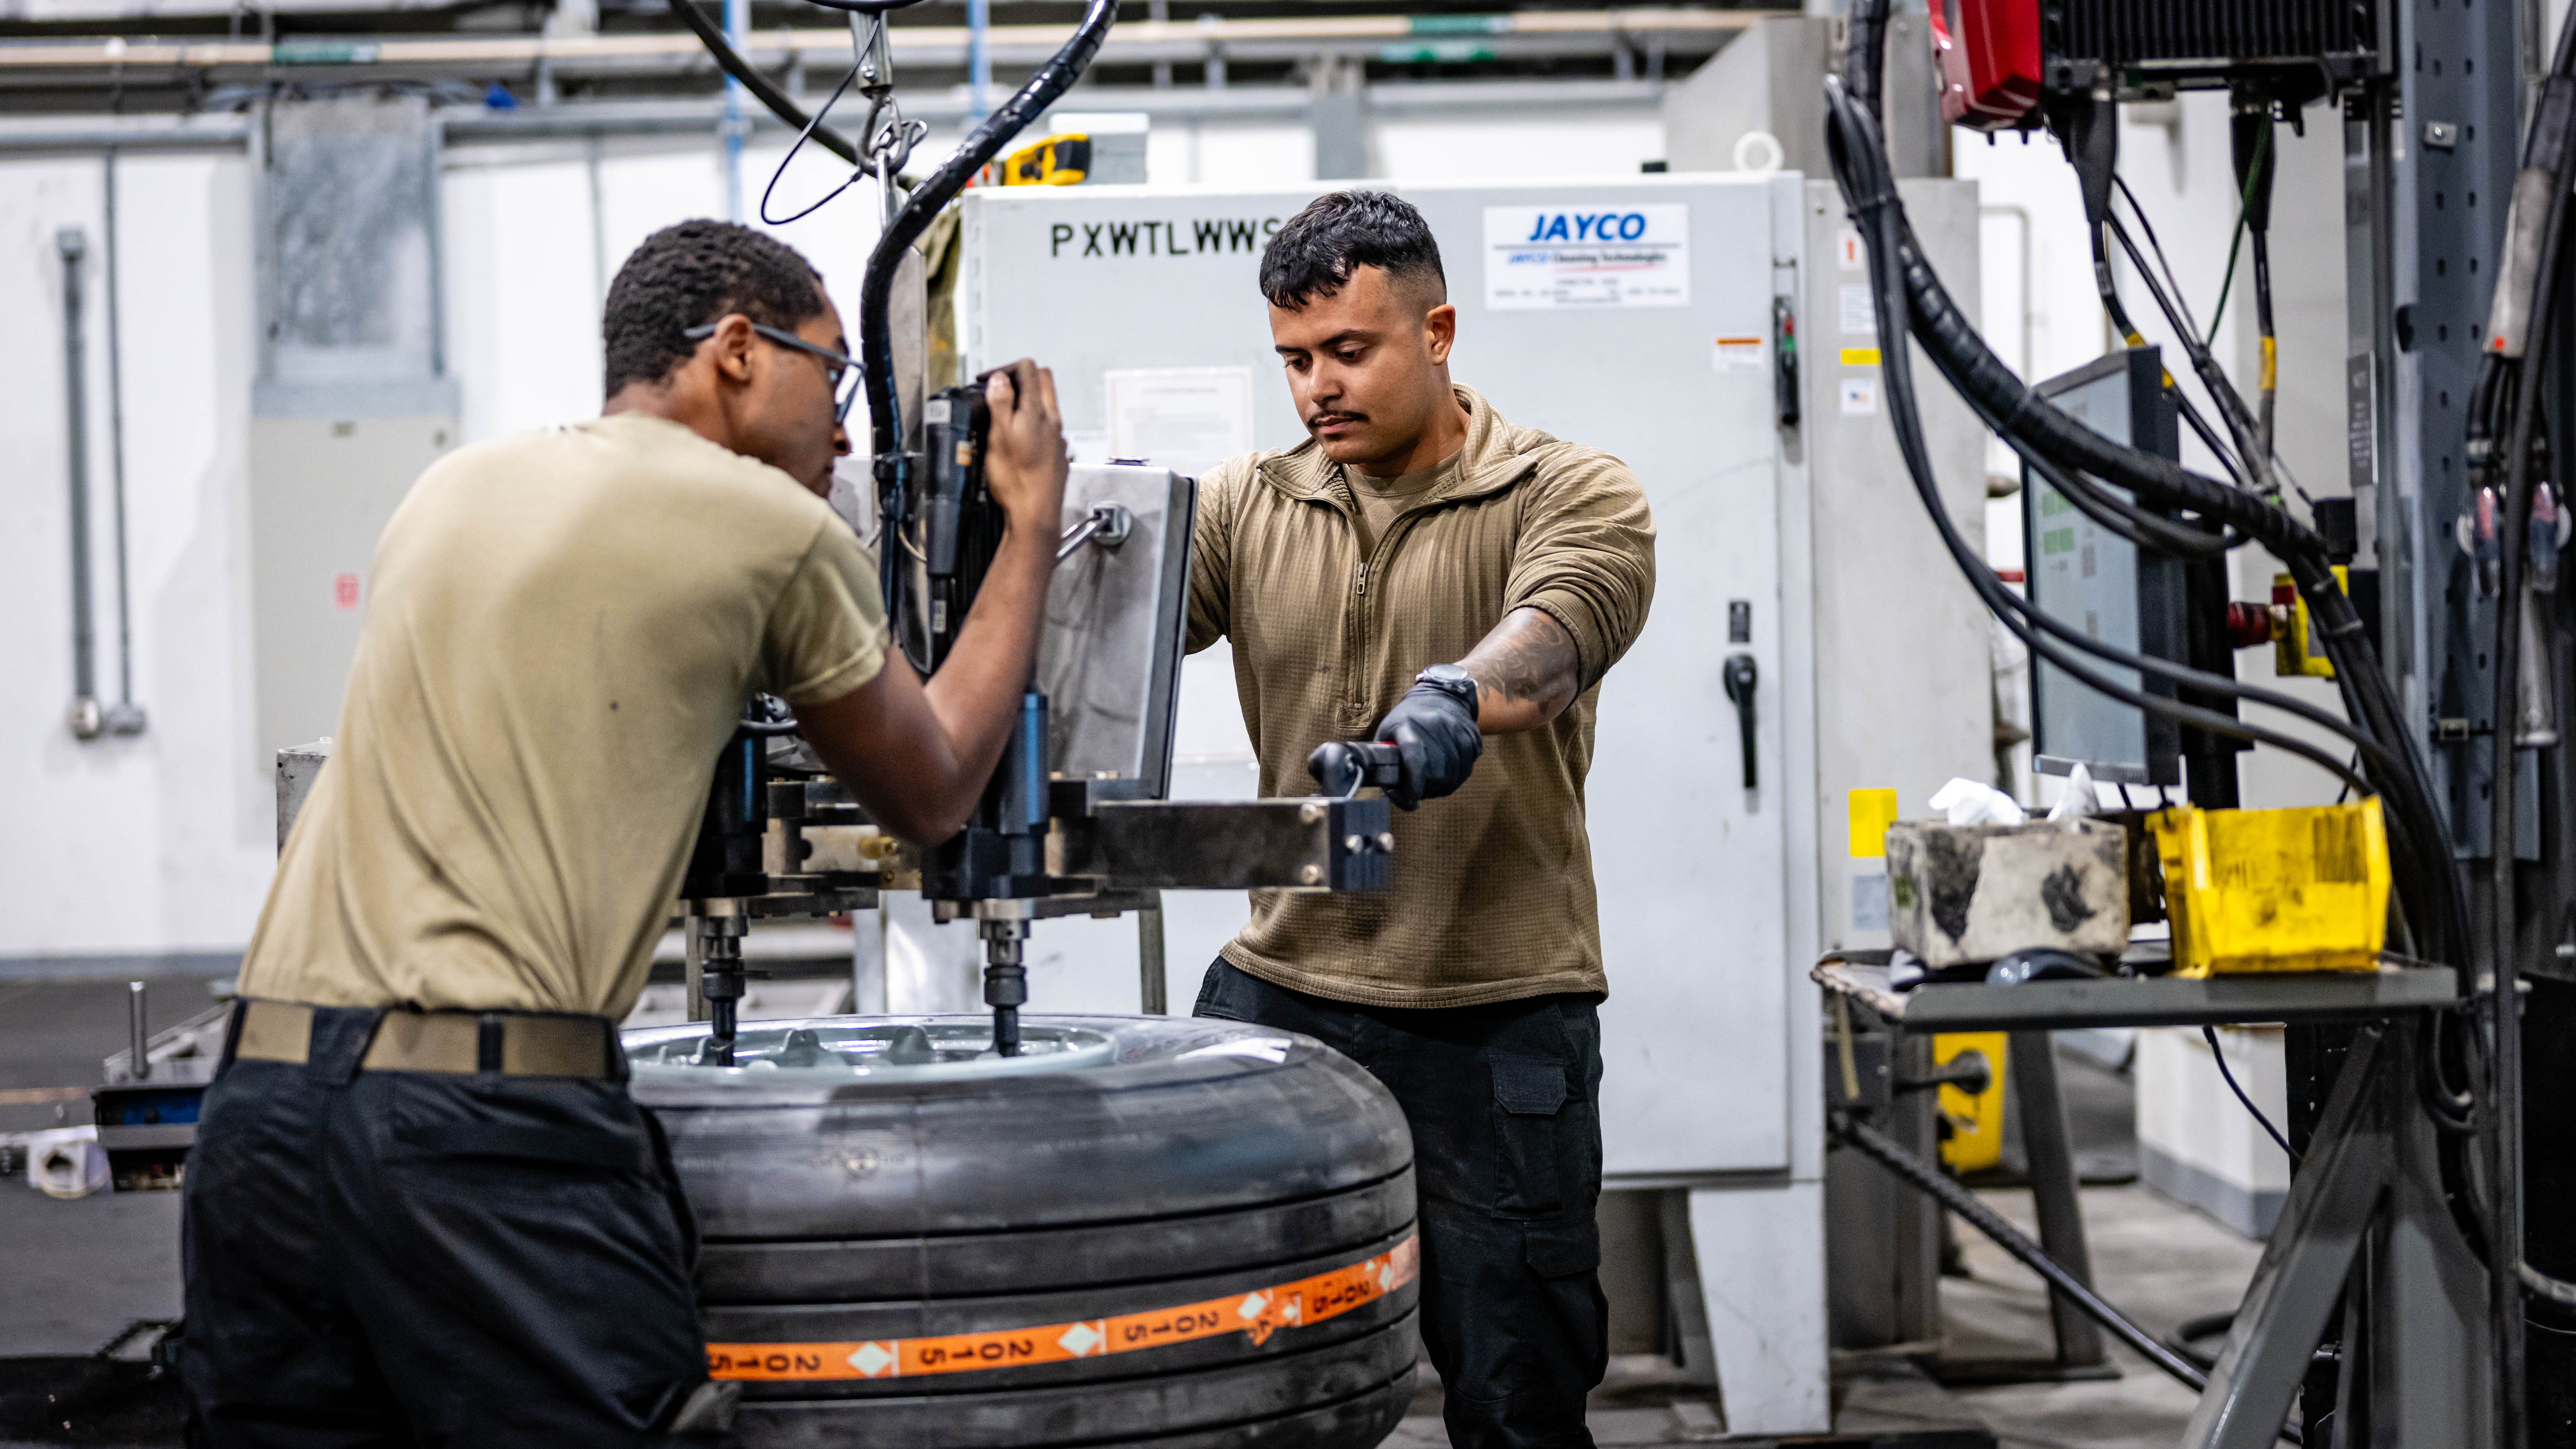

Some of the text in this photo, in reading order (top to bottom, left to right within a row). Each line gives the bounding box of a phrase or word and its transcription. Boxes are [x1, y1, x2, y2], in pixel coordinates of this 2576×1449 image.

[1529, 213, 1646, 241] JAYCO
[1125, 1310, 1219, 1343] 2015
[920, 1339, 1034, 1366] 2015
